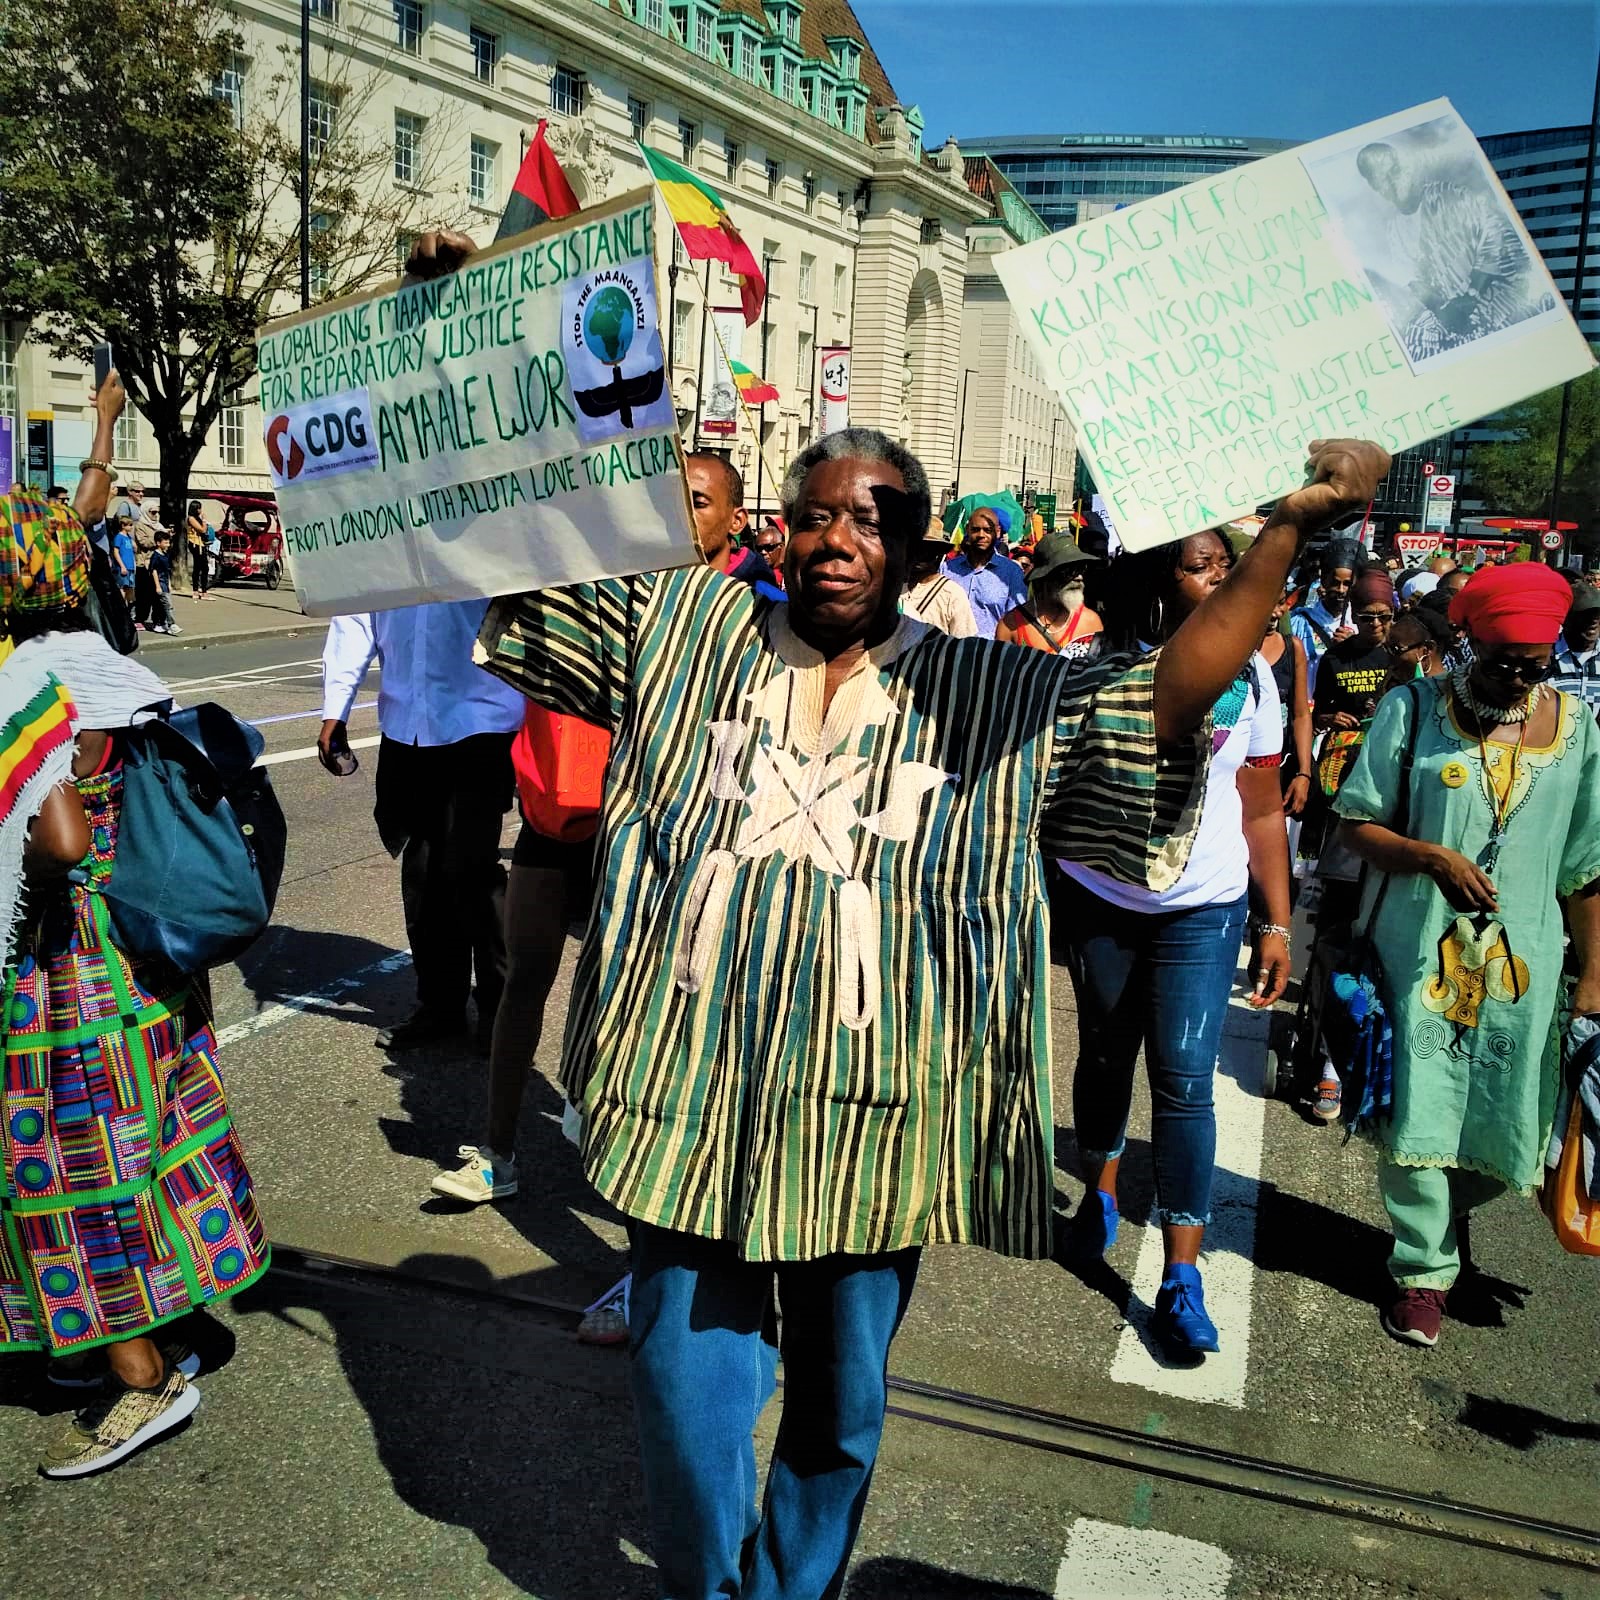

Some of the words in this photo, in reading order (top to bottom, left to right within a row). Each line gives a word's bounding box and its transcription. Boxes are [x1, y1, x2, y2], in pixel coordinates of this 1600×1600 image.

[1030, 260, 1167, 347] KWAME
[1168, 196, 1328, 288] NKRUMAH
[1046, 174, 1259, 284] OSAGYEFO
[258, 304, 371, 374] GLOBALISING
[378, 257, 513, 336] MAANGAMIZI
[520, 205, 653, 294] RESISTANCE
[573, 313, 584, 348] STOP
[577, 283, 593, 308] THE
[594, 270, 645, 330] MAANGAMIZI
[1058, 321, 1135, 380] OUR
[1134, 254, 1307, 346] VISIONARY
[260, 371, 296, 412] FOR
[301, 329, 427, 401] REPARATORY
[434, 298, 526, 366] JUSTICE
[1066, 278, 1373, 418] MAATUBUNTUMAN
[305, 406, 367, 457] CDG
[378, 375, 487, 472] AMAALE
[487, 350, 577, 441] WOR
[1097, 384, 1278, 488] REPARATORY
[1289, 333, 1404, 409] JUSTICE
[285, 521, 330, 556] FROM
[332, 501, 405, 546] LONDON
[408, 487, 456, 528] WITH
[461, 471, 527, 516] ALUTA
[529, 456, 580, 501] LOVE
[581, 452, 606, 486] TO
[608, 435, 680, 488] ACCRA
[1162, 503, 1218, 537] FOR
[1225, 457, 1304, 507] GLOB
[1425, 464, 1434, 474] D
[1402, 539, 1437, 550] STOP
[1545, 535, 1559, 544] 20
